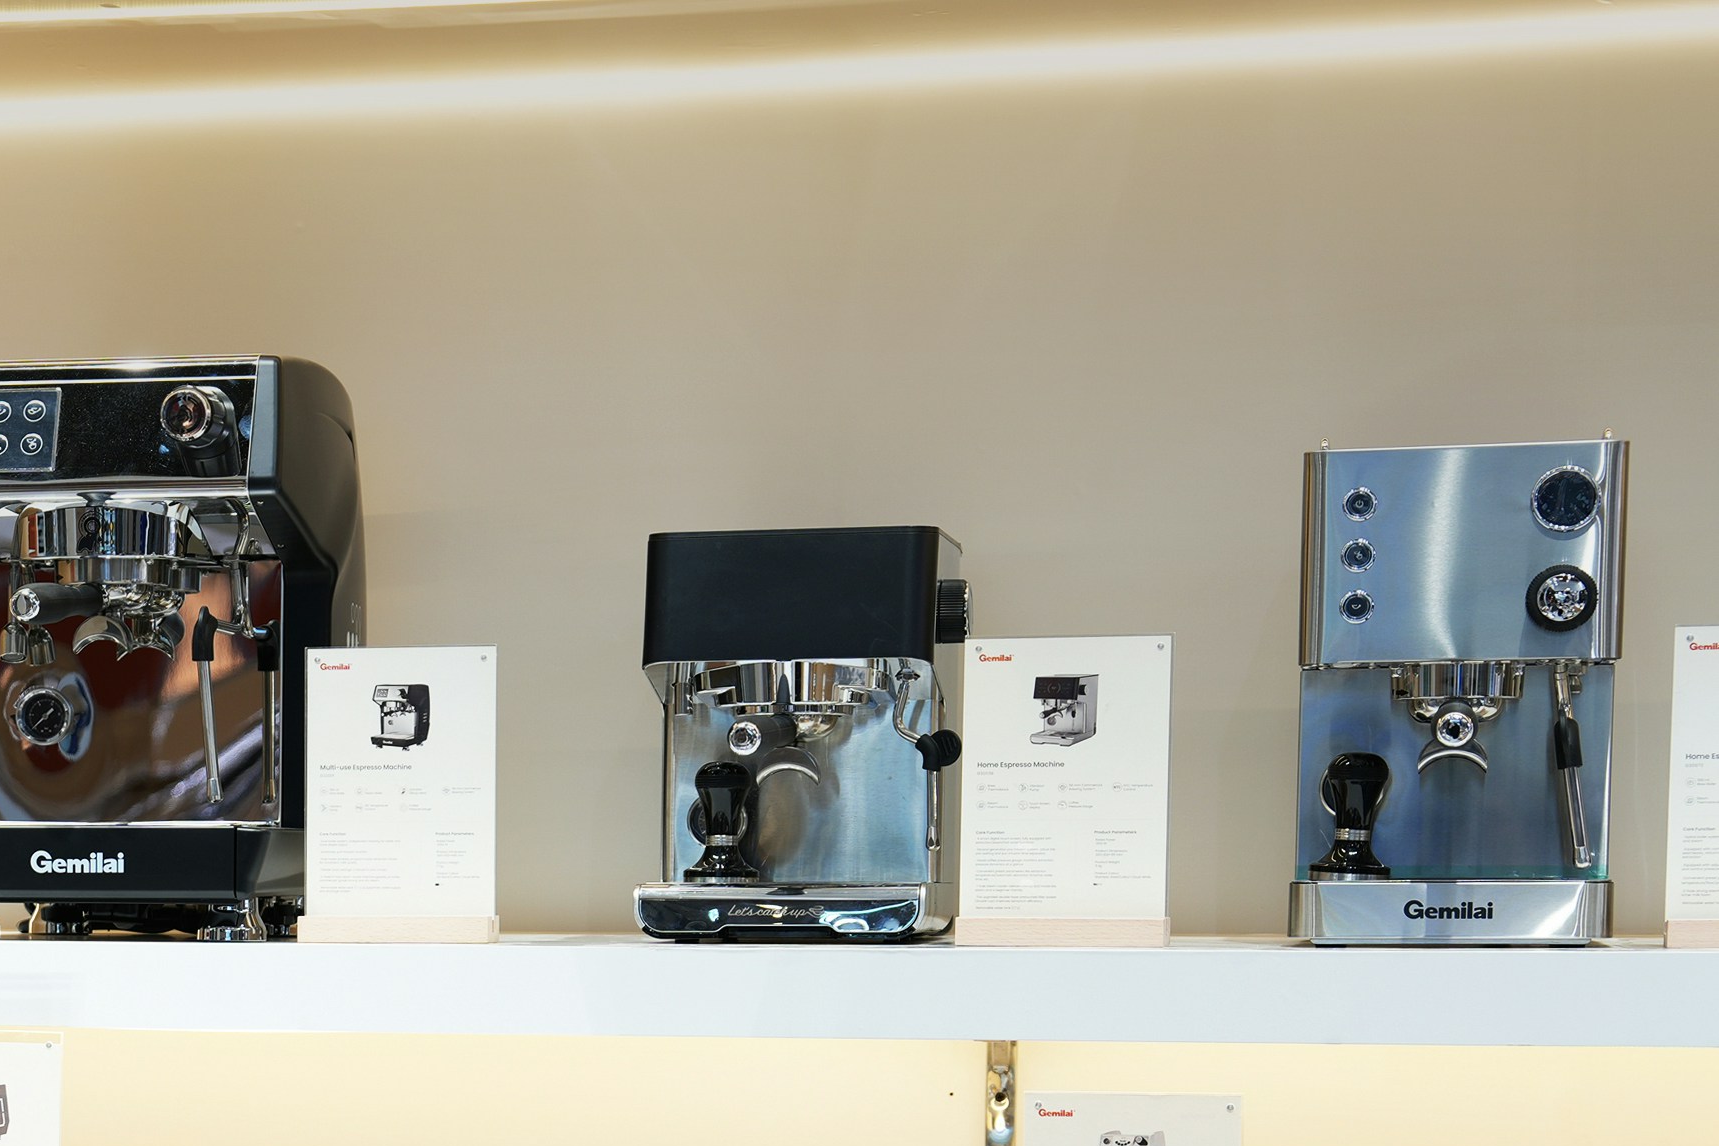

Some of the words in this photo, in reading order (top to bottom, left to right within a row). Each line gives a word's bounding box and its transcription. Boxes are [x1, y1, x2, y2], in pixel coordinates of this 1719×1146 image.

[979, 653, 1012, 662] Gemilai
[320, 663, 350, 671] Gemilai
[352, 764, 382, 772] Espresso
[1000, 761, 1032, 770] Espresso
[1033, 760, 1065, 768] Machine
[30, 850, 125, 874] Gemilai
[1403, 900, 1494, 919] Gemilai
[1038, 1108, 1074, 1117] Gemilai
